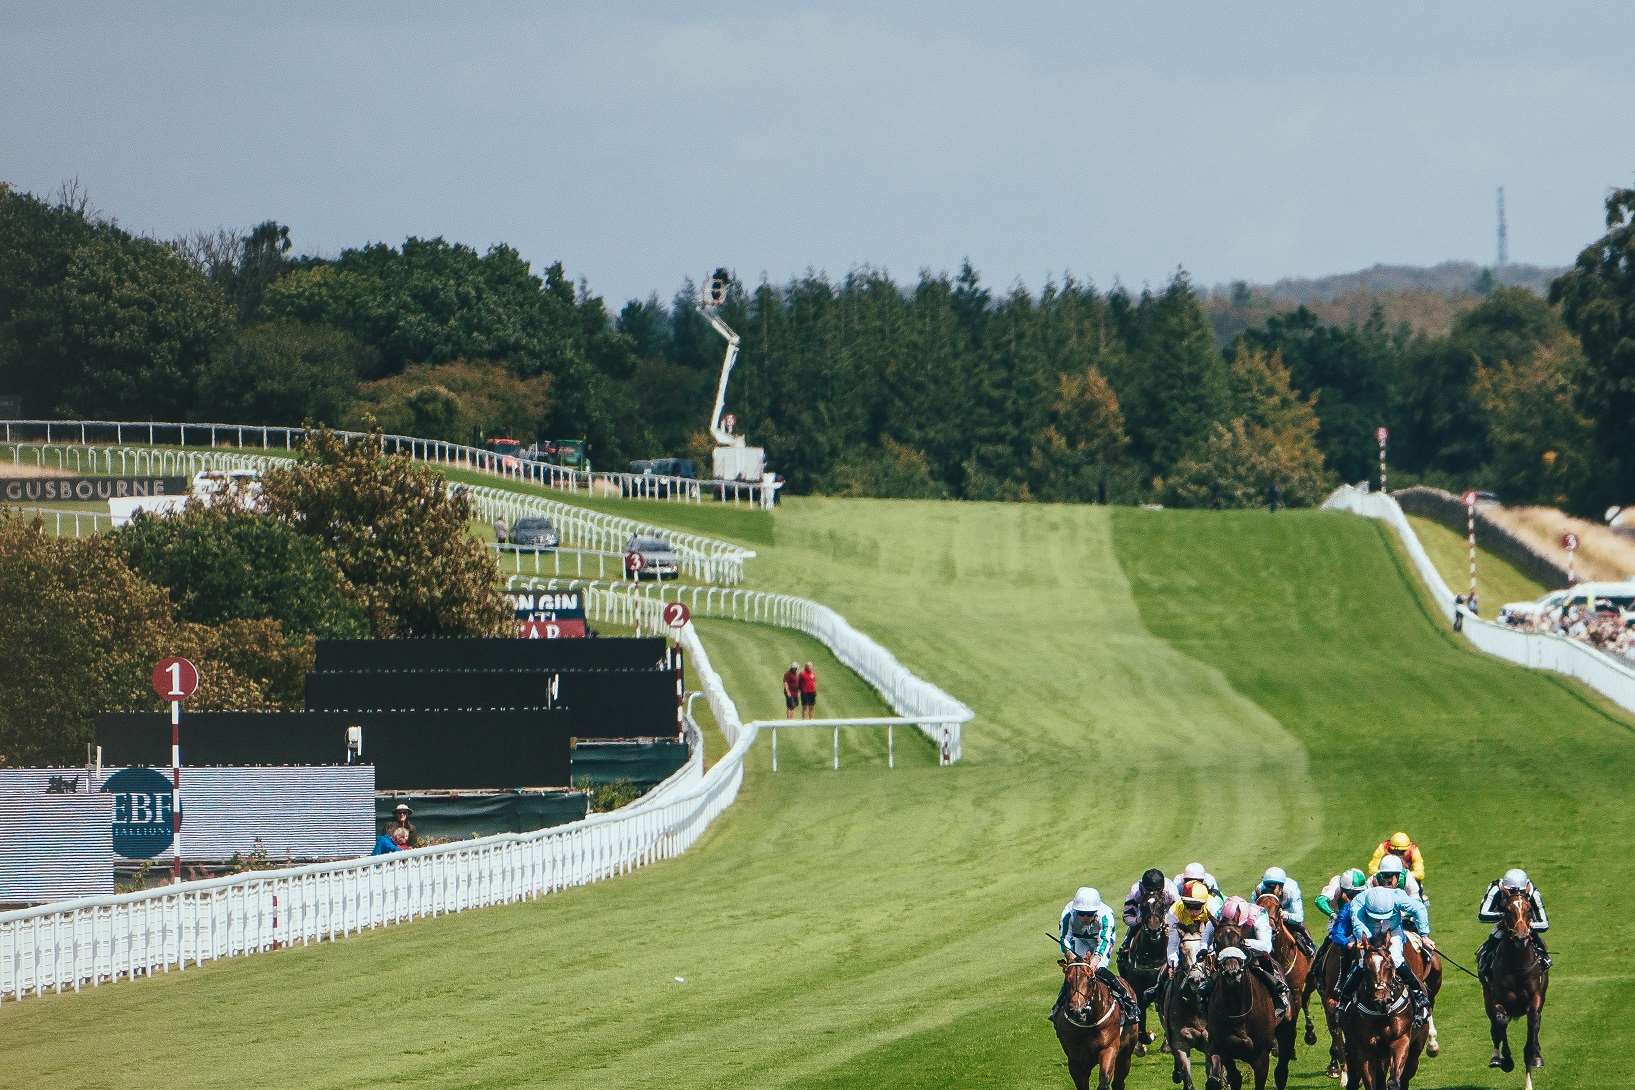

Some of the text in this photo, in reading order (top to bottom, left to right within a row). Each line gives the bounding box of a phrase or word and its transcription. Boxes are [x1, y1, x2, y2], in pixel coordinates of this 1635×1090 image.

[6, 480, 165, 499] GUSBOURNE
[630, 552, 641, 571] 3
[670, 604, 684, 626] 2
[165, 662, 185, 695] 1
[112, 793, 172, 824] EBF
[114, 828, 171, 836] TALLIONS
